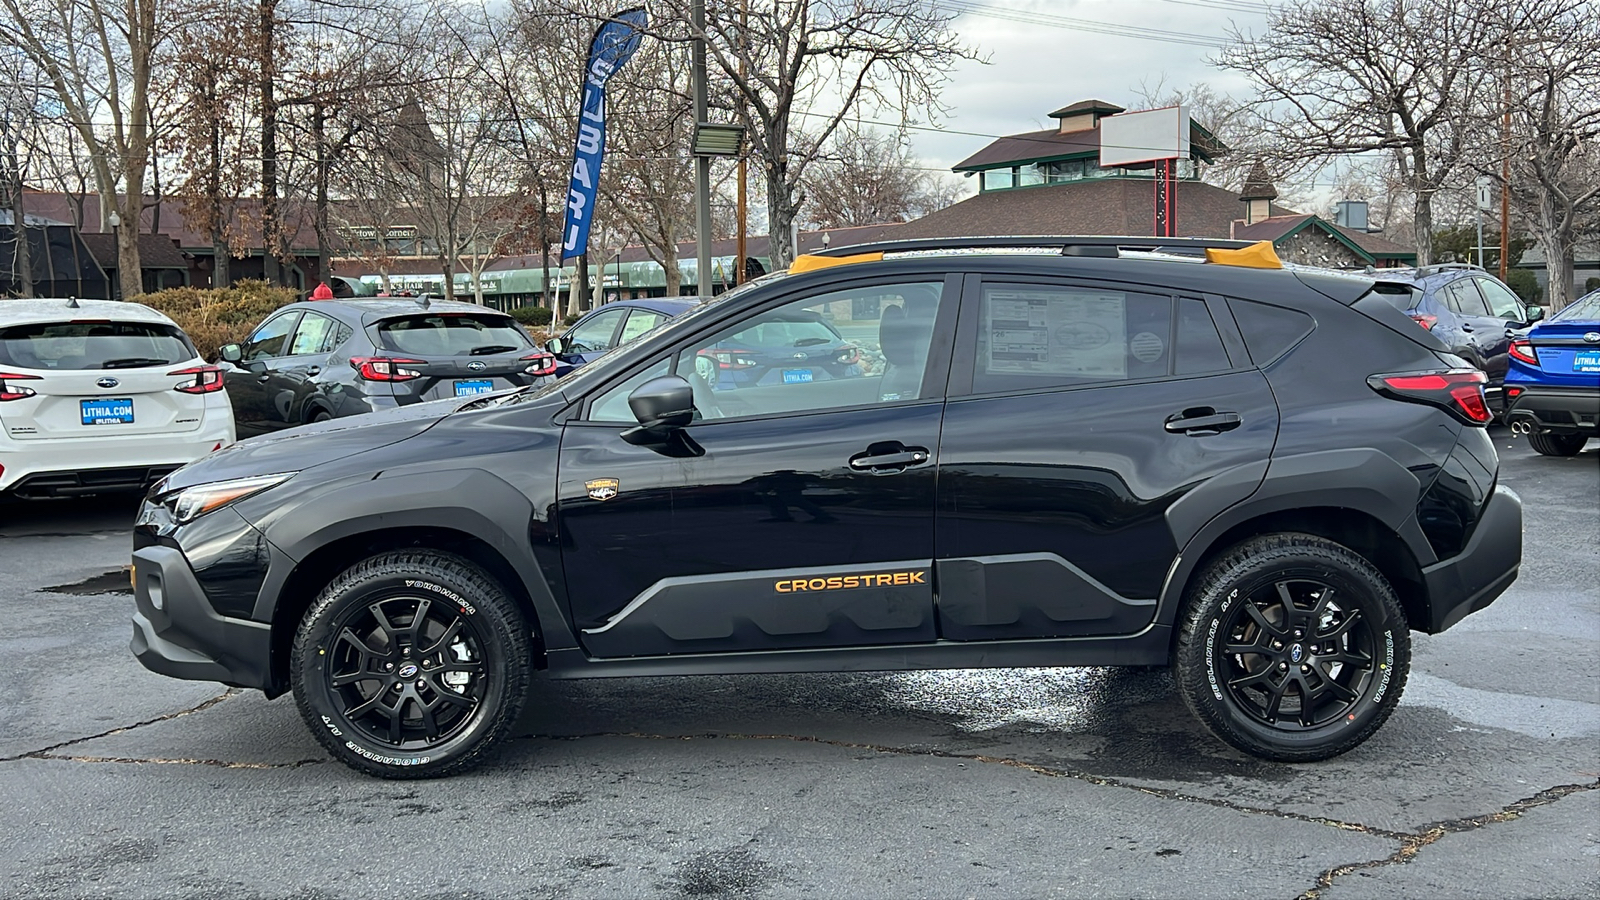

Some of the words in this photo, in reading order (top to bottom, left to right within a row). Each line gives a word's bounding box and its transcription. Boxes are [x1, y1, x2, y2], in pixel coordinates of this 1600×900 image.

[564, 57, 616, 251] SUBARU
[783, 373, 814, 383] LITHIA.COM
[456, 386, 493, 397] LITHIACOM
[82, 406, 133, 418] LITHIA.COM
[775, 571, 925, 593] CROSSTREK
[405, 580, 476, 615] YOKOHAMA
[1221, 588, 1238, 612] A/T
[1206, 618, 1223, 701] GEOLANDAR
[1373, 630, 1394, 703] YOKOHAMA
[321, 715, 343, 736] A/T
[345, 740, 431, 766] GEOLANDAR
